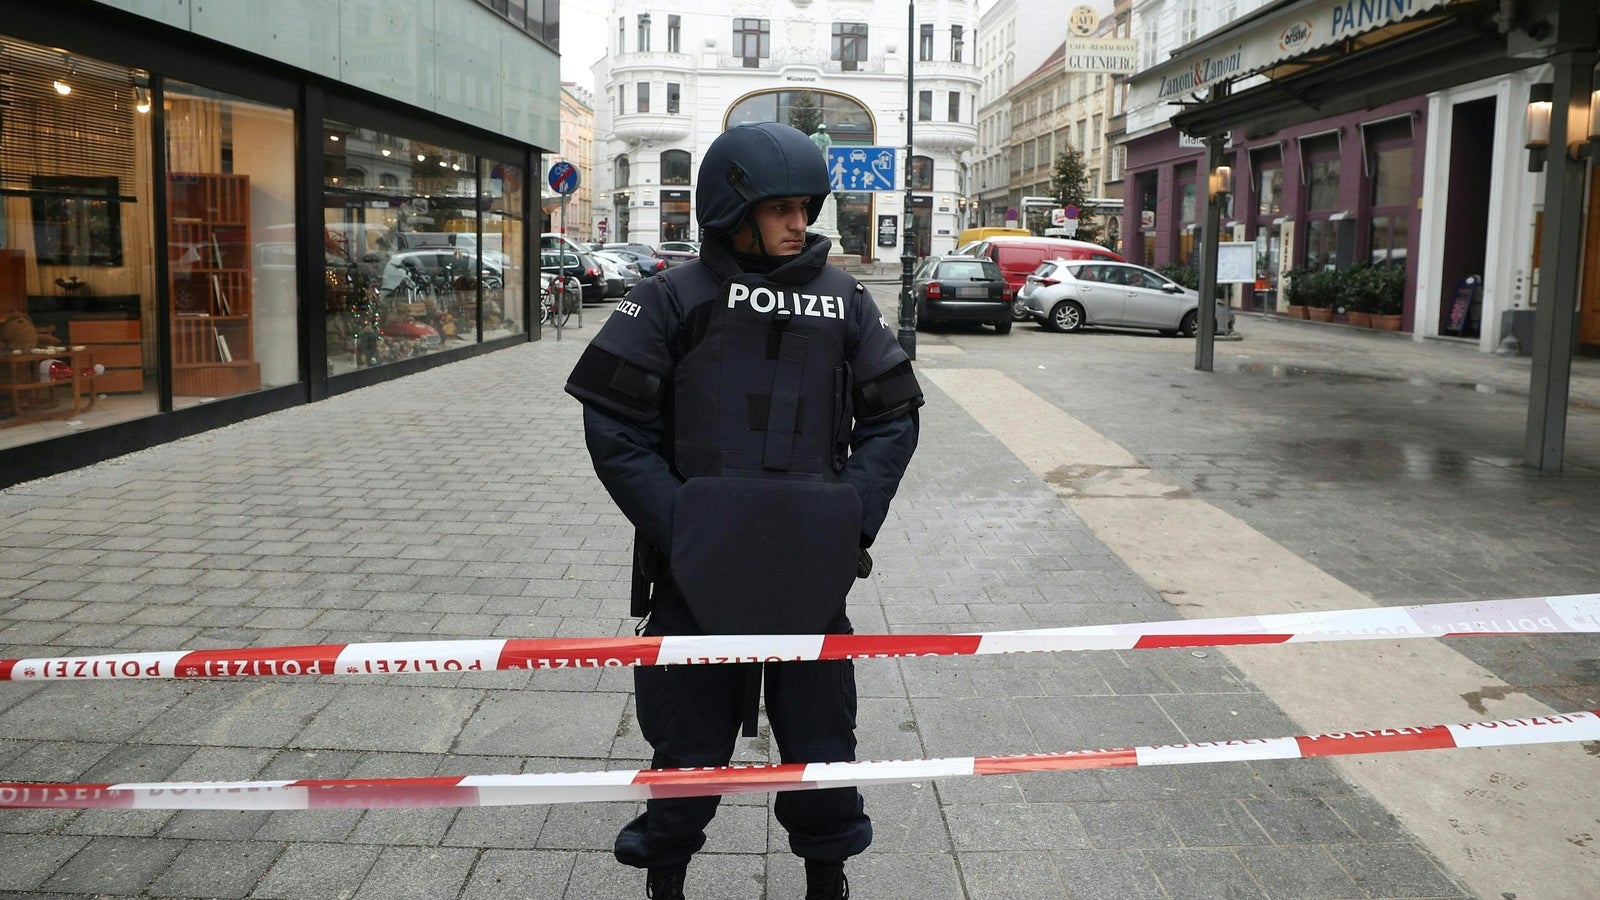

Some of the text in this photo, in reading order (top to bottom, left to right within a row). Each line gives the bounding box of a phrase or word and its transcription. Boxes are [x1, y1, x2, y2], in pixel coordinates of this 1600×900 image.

[1069, 55, 1134, 70] GUTENBERG
[727, 282, 845, 320] POLIZEI
[43, 660, 161, 677] POLIZEI
[204, 659, 322, 676] POLIZEI
